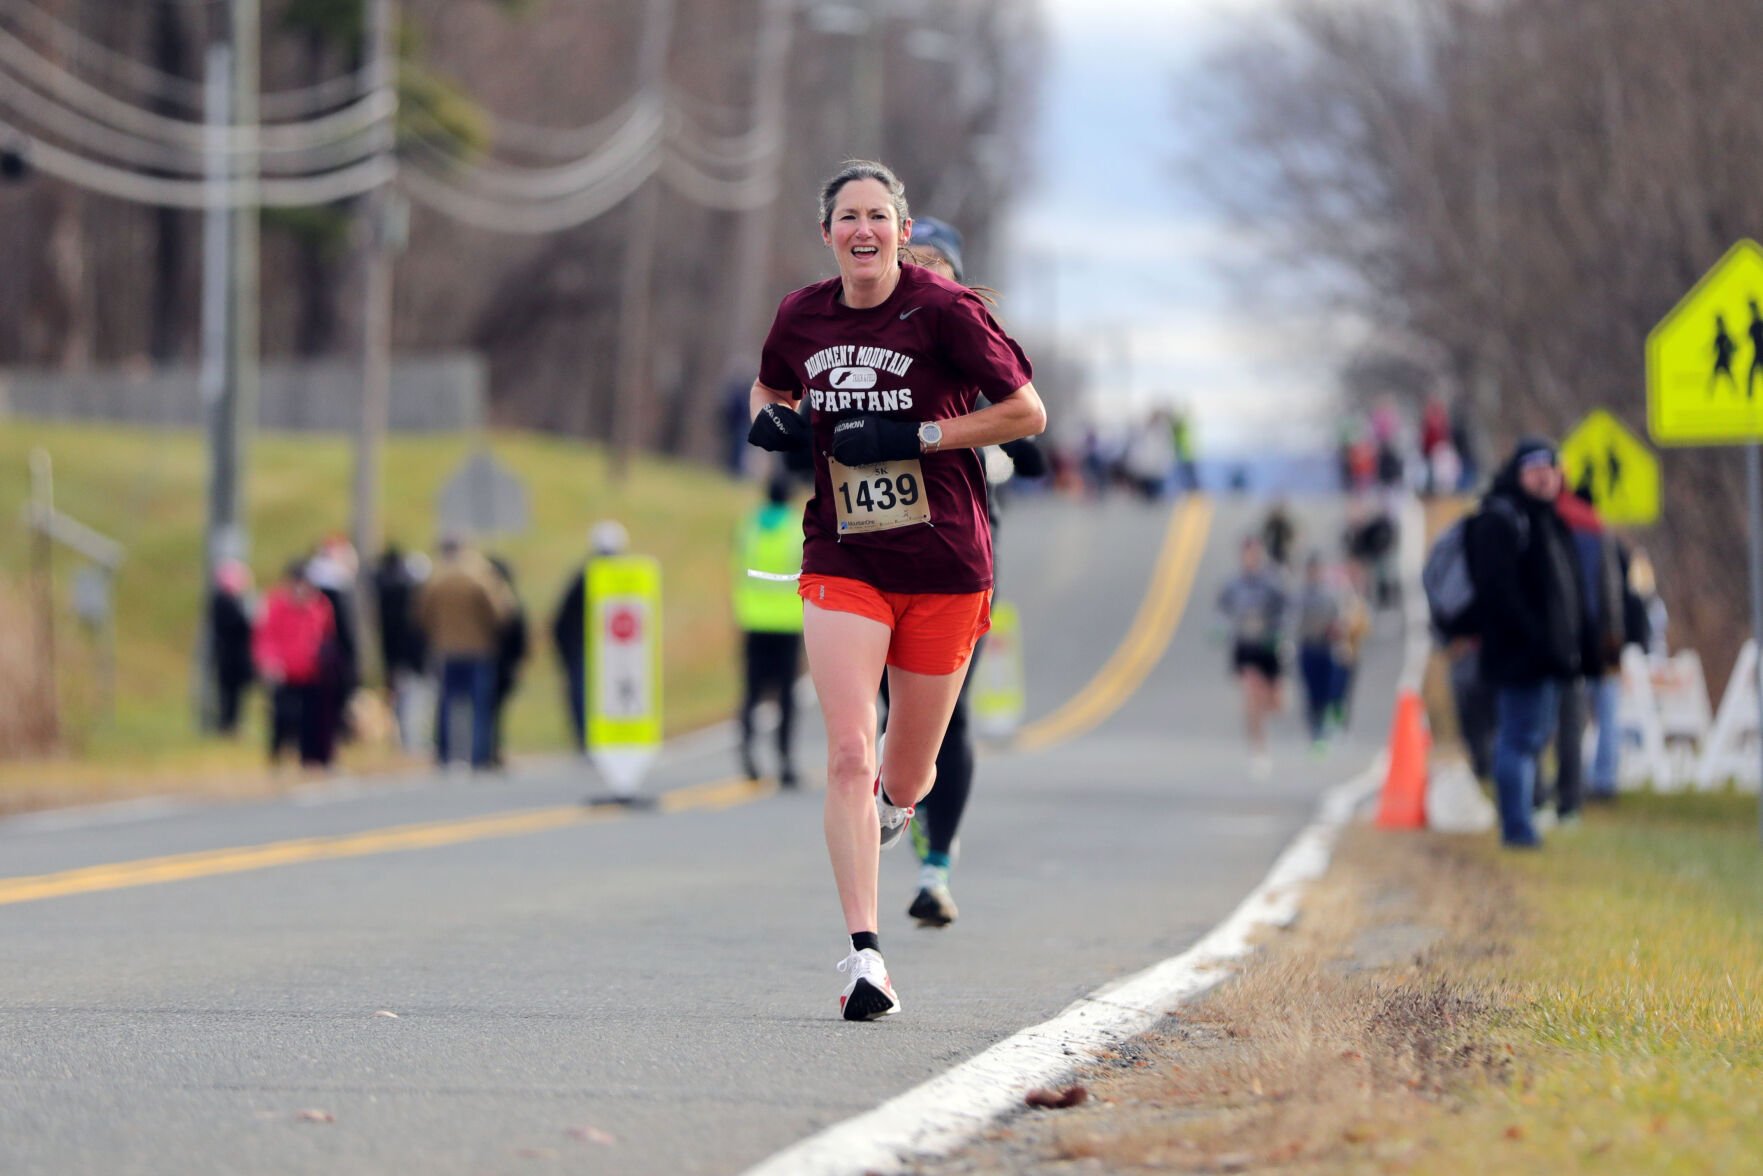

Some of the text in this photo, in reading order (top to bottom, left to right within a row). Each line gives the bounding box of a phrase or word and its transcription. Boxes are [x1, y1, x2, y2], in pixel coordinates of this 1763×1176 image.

[804, 345, 914, 380] MONUMENT MOUNTAIN
[809, 388, 913, 412] SPARTANS
[875, 467, 888, 476] 5K
[839, 473, 919, 514] 1439
